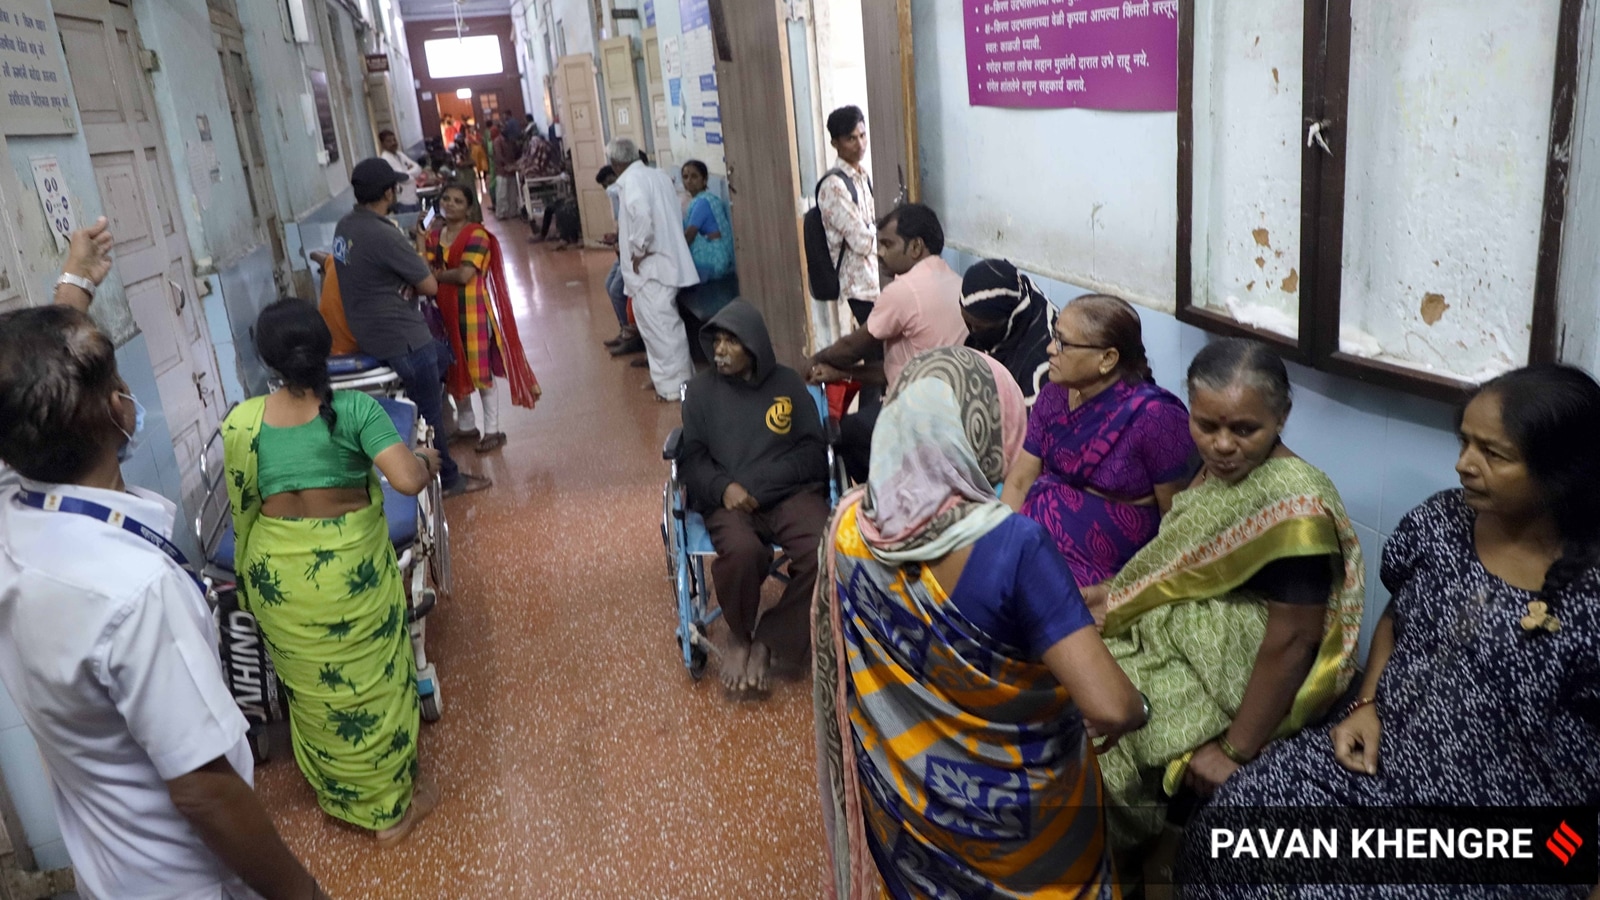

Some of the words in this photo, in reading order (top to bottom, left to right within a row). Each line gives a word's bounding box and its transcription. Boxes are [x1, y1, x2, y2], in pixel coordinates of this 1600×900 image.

[1066, 10, 1087, 29] कृपया
[1090, 7, 1120, 22] आपल्या
[1034, 59, 1052, 73] लहान
[1054, 53, 1076, 74] मुलांनी
[1078, 56, 1098, 70] दारात
[1101, 50, 1113, 68] उभे
[1117, 54, 1132, 73] राहू
[1039, 76, 1064, 94] सहकार्य
